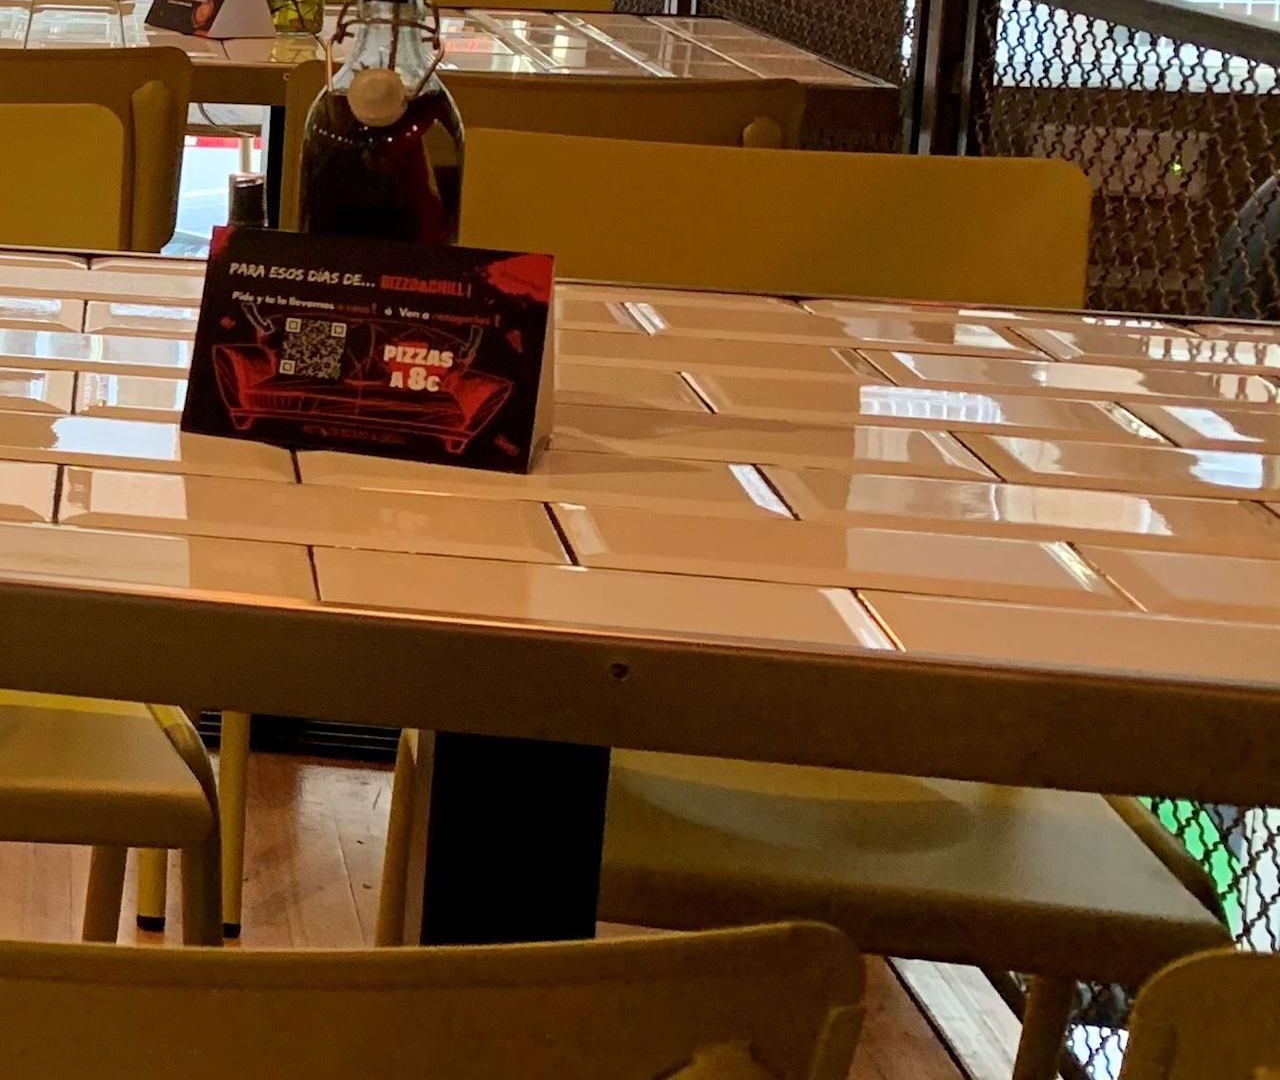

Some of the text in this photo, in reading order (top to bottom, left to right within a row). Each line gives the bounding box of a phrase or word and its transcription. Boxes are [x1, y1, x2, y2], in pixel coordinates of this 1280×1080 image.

[228, 262, 265, 278] PARA
[269, 266, 305, 281] ESOS
[382, 343, 455, 369] PIZZAS
[389, 371, 404, 389] A
